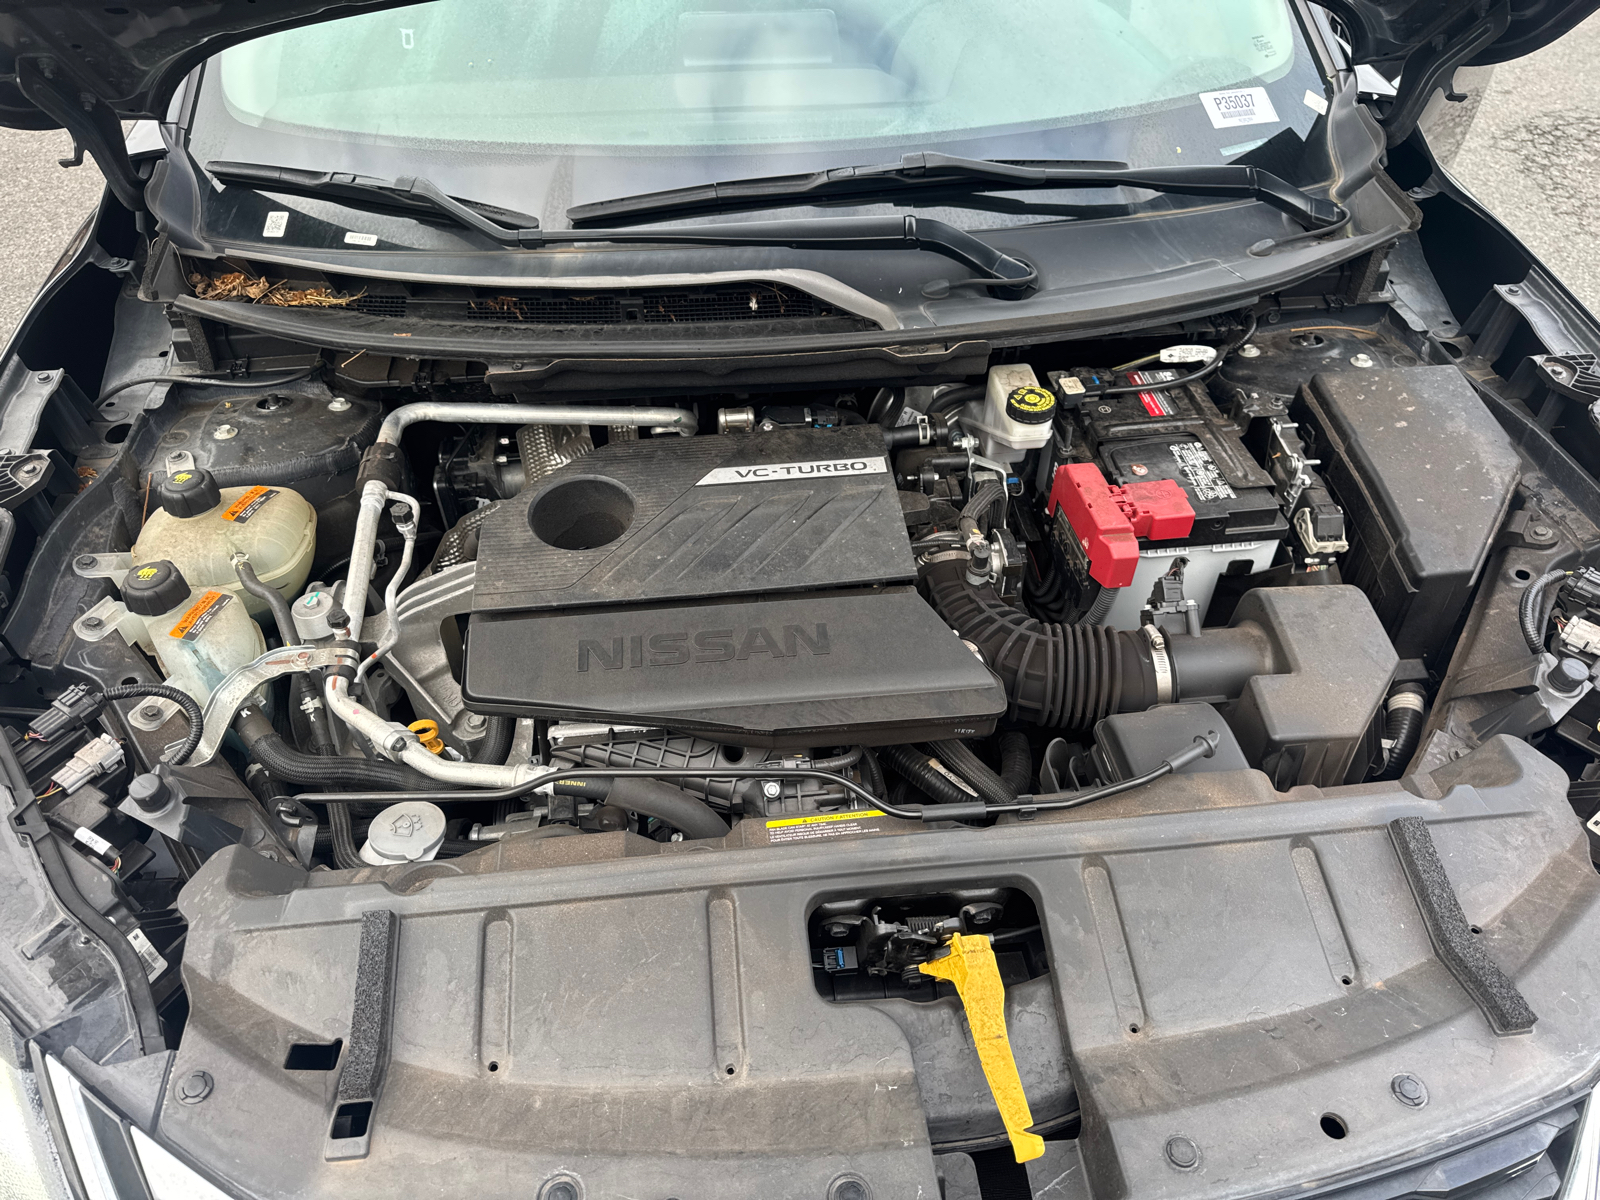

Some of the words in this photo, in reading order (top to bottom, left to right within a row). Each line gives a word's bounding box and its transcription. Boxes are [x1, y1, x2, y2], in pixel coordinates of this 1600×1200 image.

[1213, 94, 1255, 111] P35037
[735, 461, 868, 478] VC-TURBO
[577, 622, 831, 673] NISSAN
[240, 708, 251, 718] K
[309, 713, 316, 723] K
